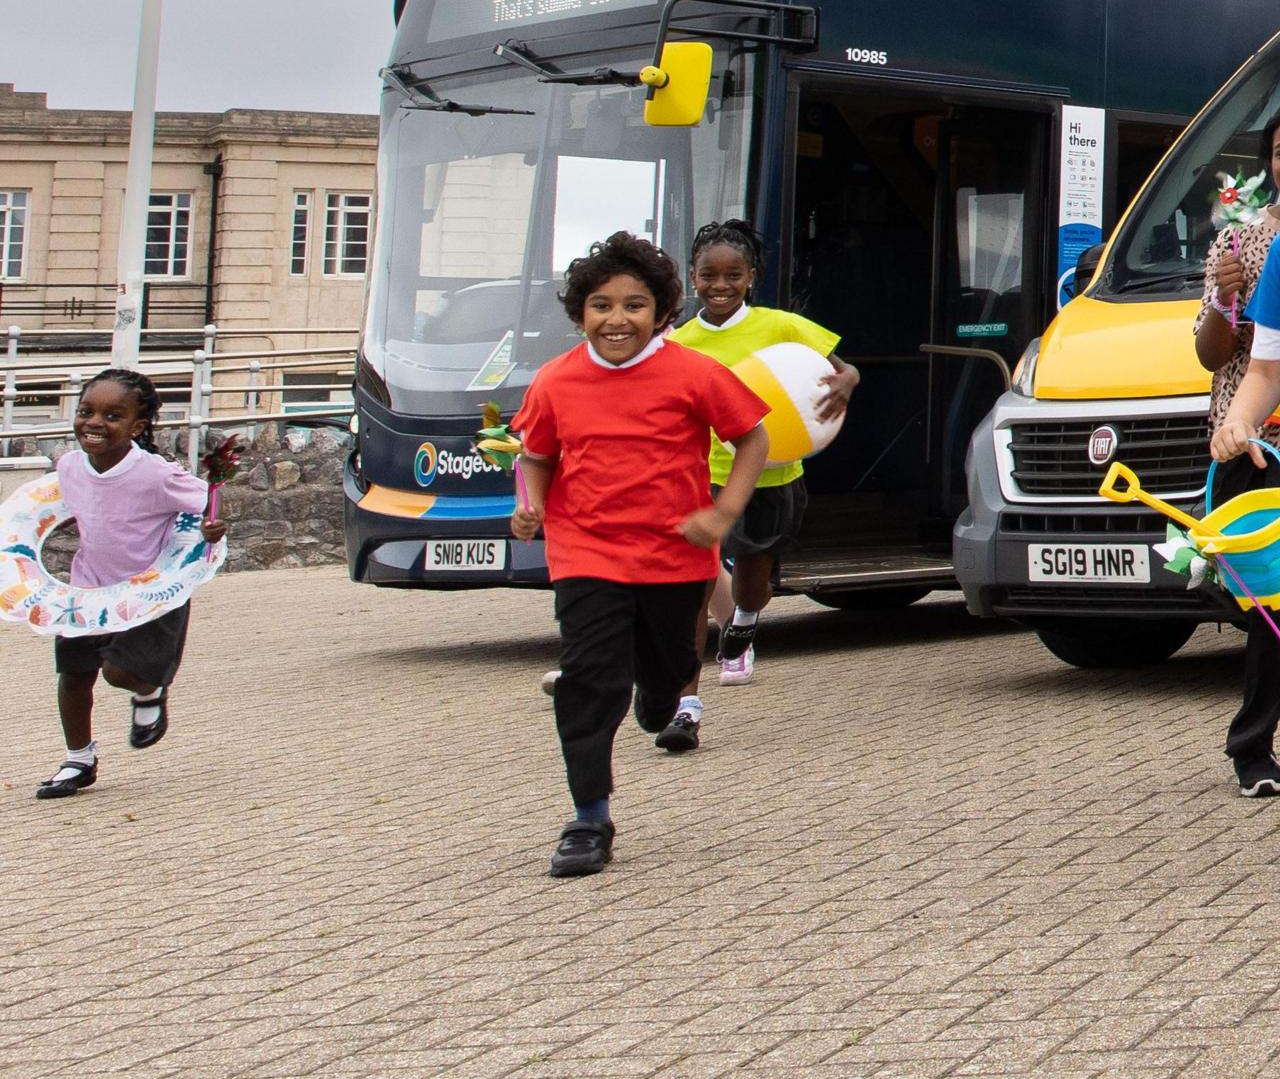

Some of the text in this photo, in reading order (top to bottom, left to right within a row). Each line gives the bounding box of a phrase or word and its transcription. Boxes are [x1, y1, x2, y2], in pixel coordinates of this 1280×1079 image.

[845, 48, 888, 65] 10985
[1069, 122, 1081, 134] Hi
[1068, 134, 1097, 148] there
[1093, 438, 1111, 455] FIAT
[434, 542, 496, 565] SN18 KUS
[1041, 548, 1135, 576] SG19 HNR
